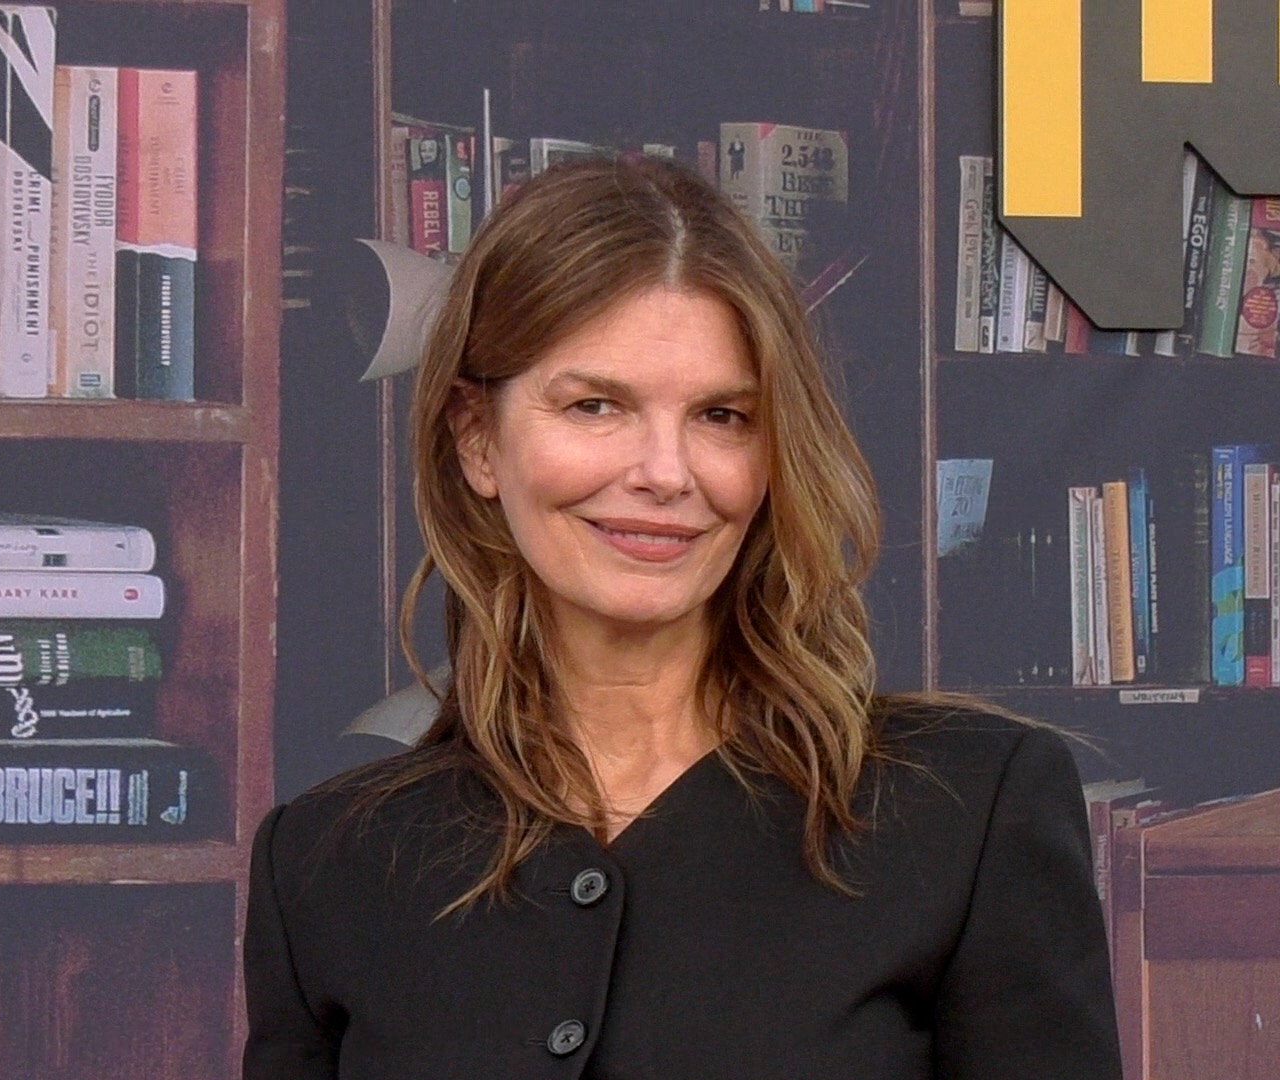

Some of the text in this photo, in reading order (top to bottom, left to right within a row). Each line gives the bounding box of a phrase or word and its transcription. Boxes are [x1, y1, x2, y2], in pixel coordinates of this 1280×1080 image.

[73, 155, 93, 246] DOSTOYEVSKY
[94, 174, 113, 228] FYODOR
[422, 191, 440, 238] REBEL
[1190, 214, 1208, 247] EGO
[26, 245, 41, 338] PUNISHMENT
[1214, 235, 1237, 312] Psychology
[80, 251, 100, 353] THE IDIOT
[1222, 518, 1234, 566] LANGUAGE
[39, 589, 79, 600] KARR
